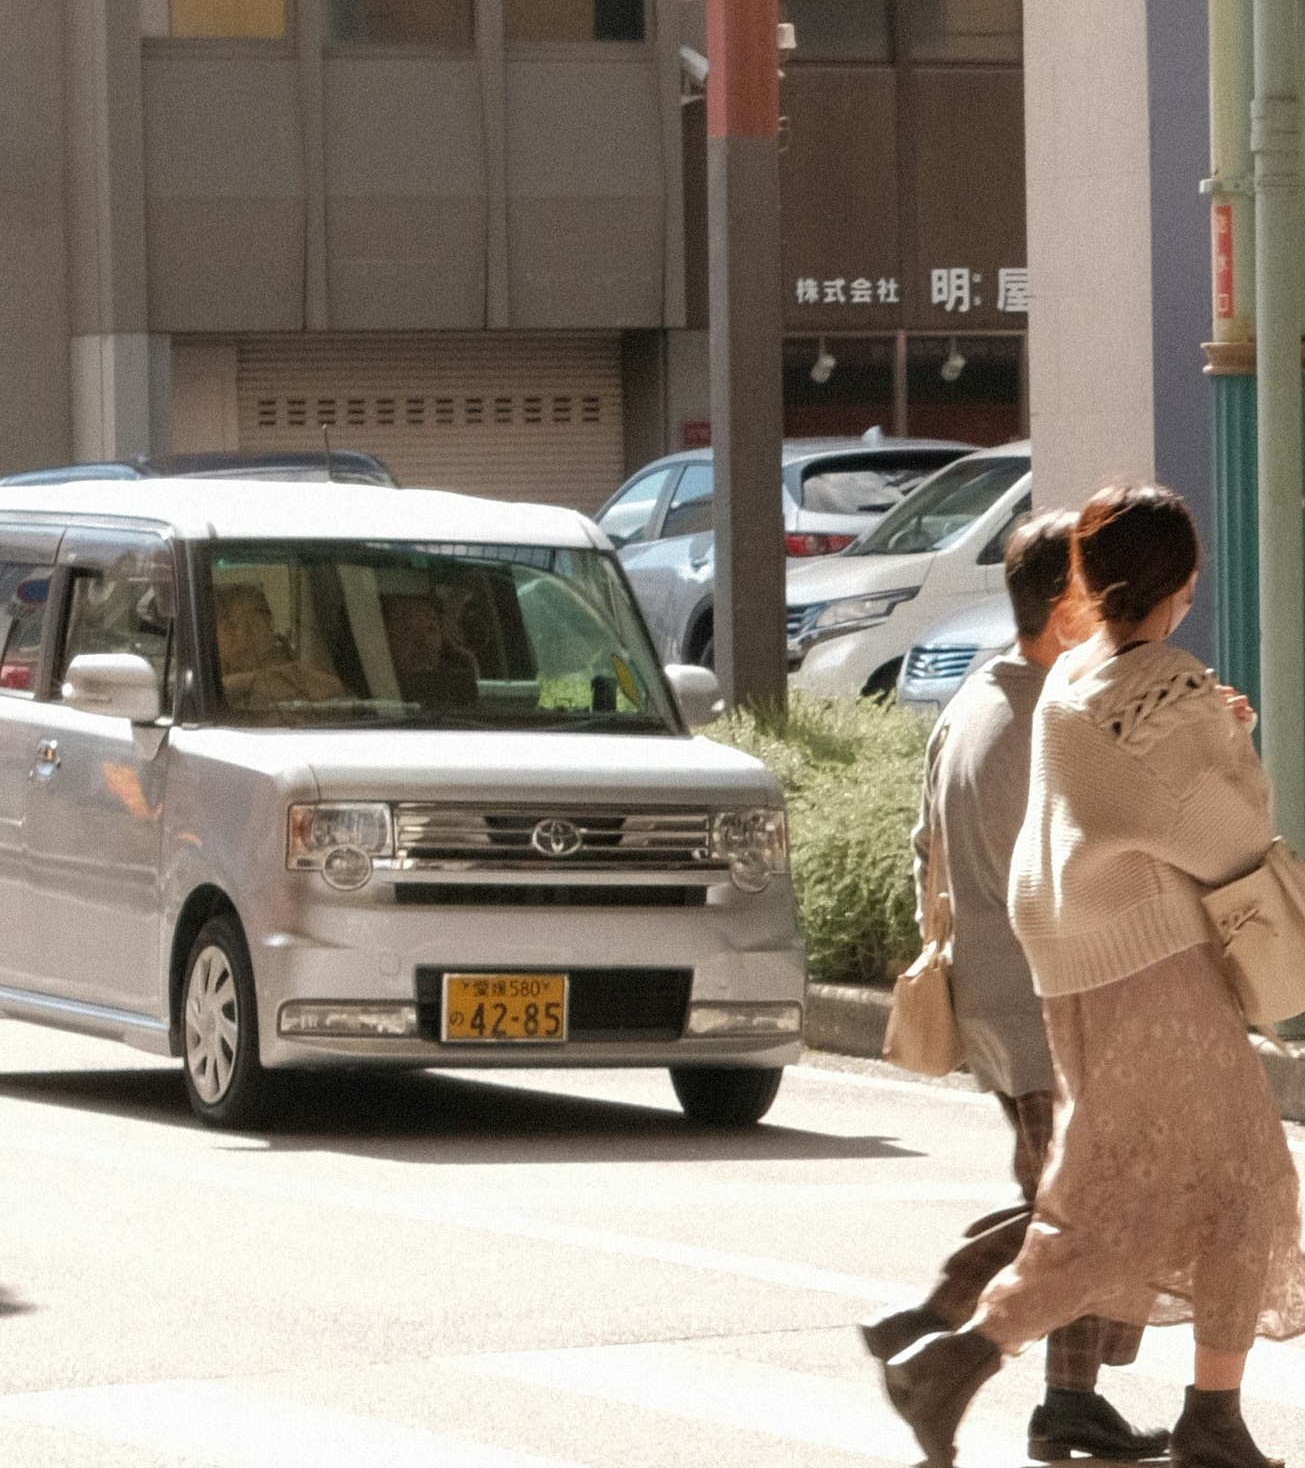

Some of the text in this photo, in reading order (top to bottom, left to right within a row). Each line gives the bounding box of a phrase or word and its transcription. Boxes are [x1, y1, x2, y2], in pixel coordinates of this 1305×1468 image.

[796, 277, 900, 304] 株式会社
[469, 1002, 560, 1036] 42-85
